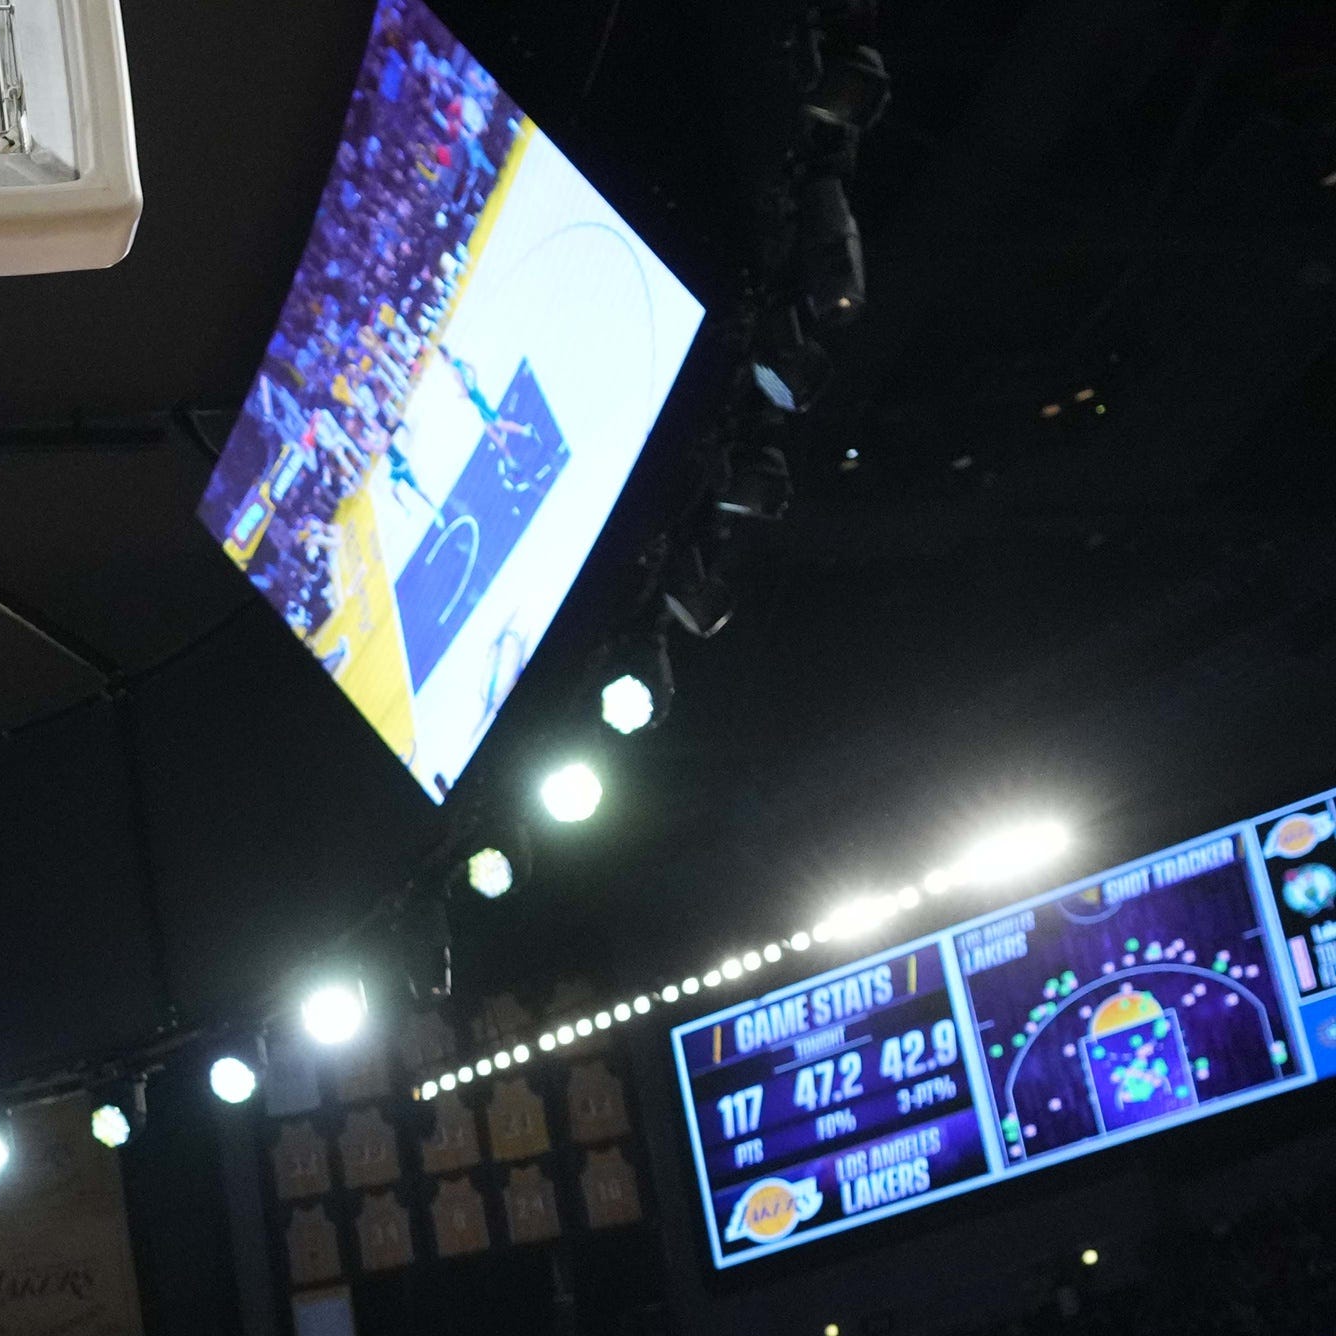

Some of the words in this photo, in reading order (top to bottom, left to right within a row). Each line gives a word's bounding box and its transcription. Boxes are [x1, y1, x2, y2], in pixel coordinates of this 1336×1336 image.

[1104, 862, 1151, 904] SHOT
[1153, 837, 1235, 892] TRACKER
[963, 932, 1029, 975] LAKERS
[735, 999, 809, 1054] GAME
[811, 964, 894, 1025] STATS
[716, 1085, 765, 1140] 117
[793, 1051, 864, 1112] 47.2
[879, 1018, 960, 1083] 42.9
[841, 1155, 931, 1215] LAKERS
